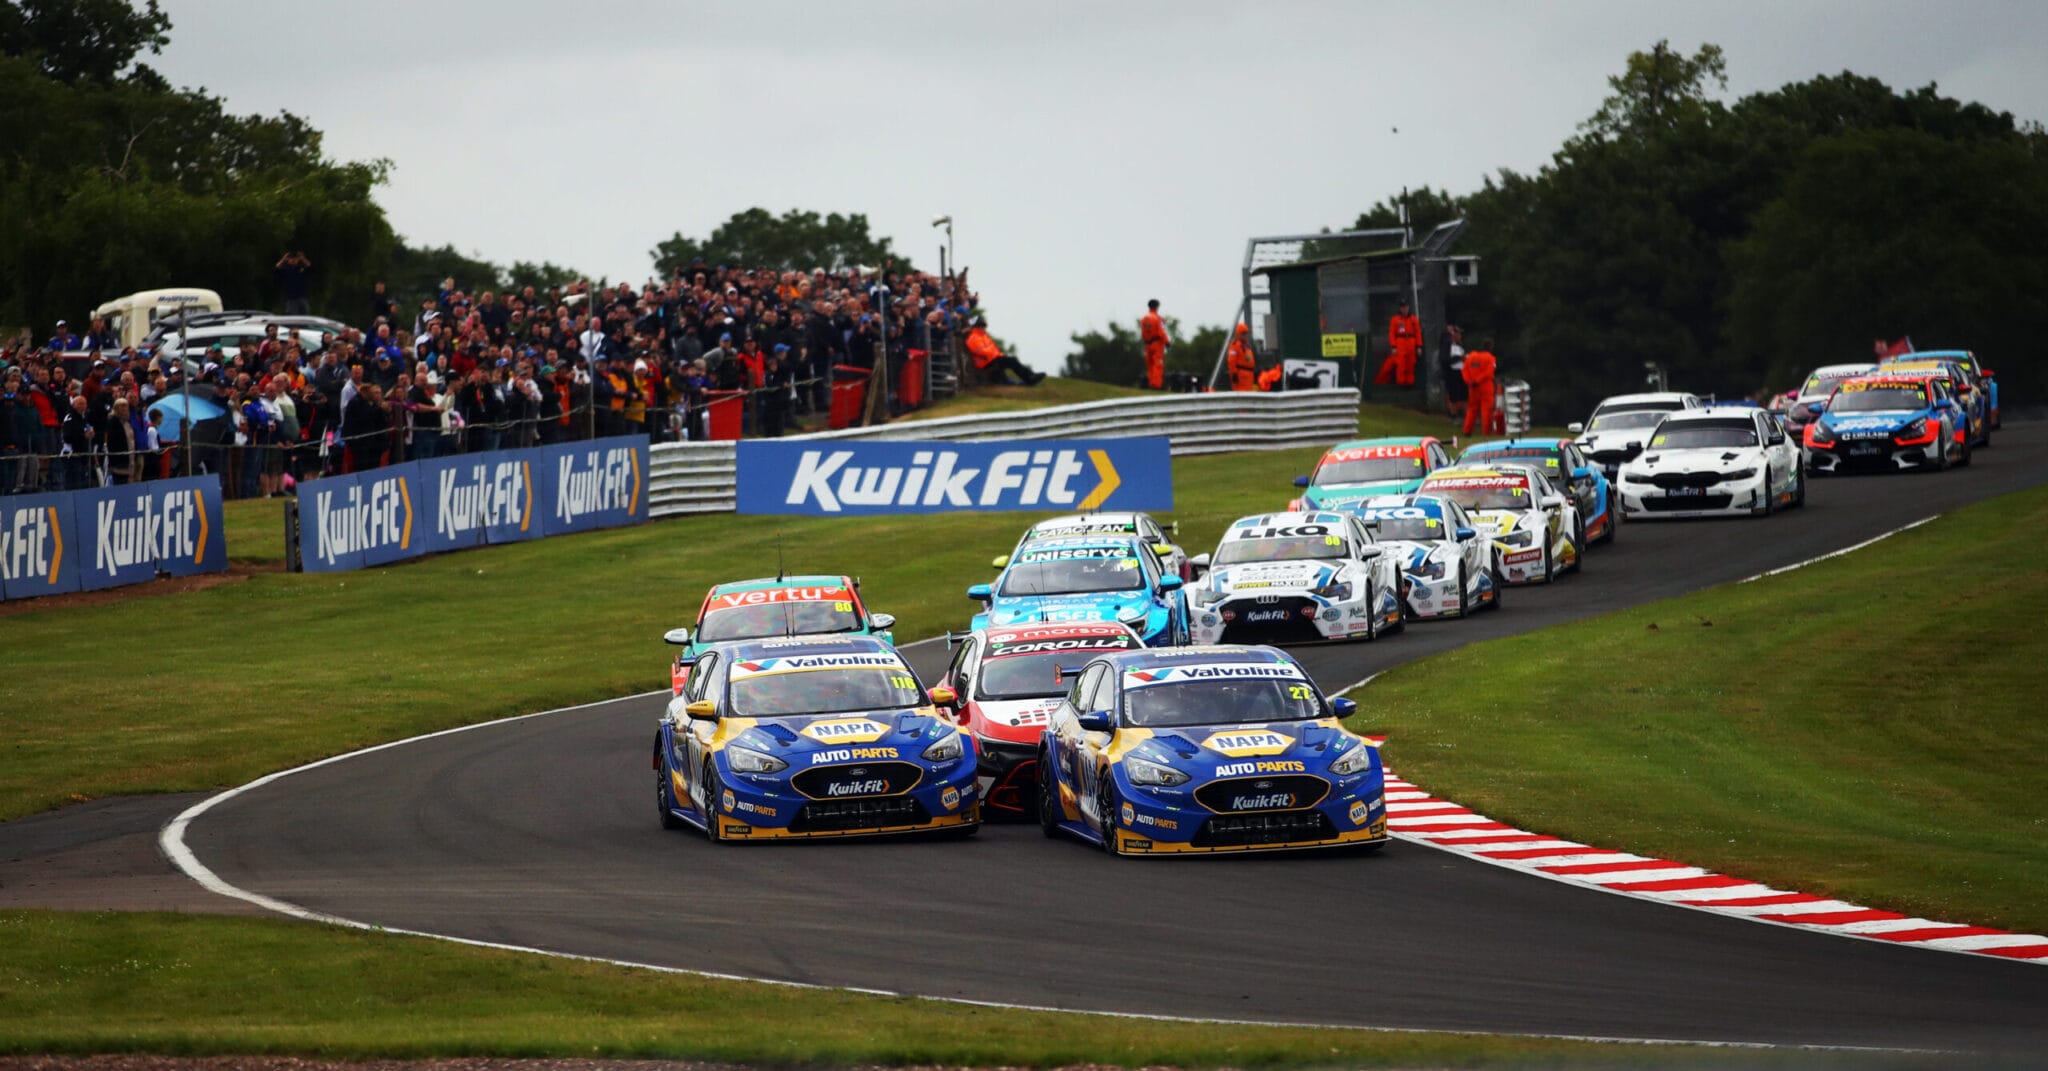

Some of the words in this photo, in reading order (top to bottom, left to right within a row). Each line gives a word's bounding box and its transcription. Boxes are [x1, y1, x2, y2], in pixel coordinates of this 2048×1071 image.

[1334, 447, 1402, 461] vertu
[1357, 508, 1428, 521] KQ
[1240, 525, 1329, 539] LKQ
[722, 587, 822, 607] vertu
[1023, 627, 1127, 639] morson
[992, 639, 1128, 656] COROLLA
[785, 656, 896, 668] Valvoline
[1180, 666, 1294, 678] Valvoline
[891, 676, 916, 690] 116
[1288, 686, 1310, 700] 27
[814, 722, 879, 737] NAPA
[1216, 734, 1283, 749] NAPA
[812, 749, 850, 764] AUTO
[852, 747, 900, 760] PARTS
[1215, 762, 1255, 777] AUTO
[1256, 760, 1306, 772] PARTS
[736, 801, 754, 812] AUTO
[754, 804, 777, 817] PARTS
[1136, 814, 1154, 826] AUTO
[1154, 817, 1178, 830] PARTS
